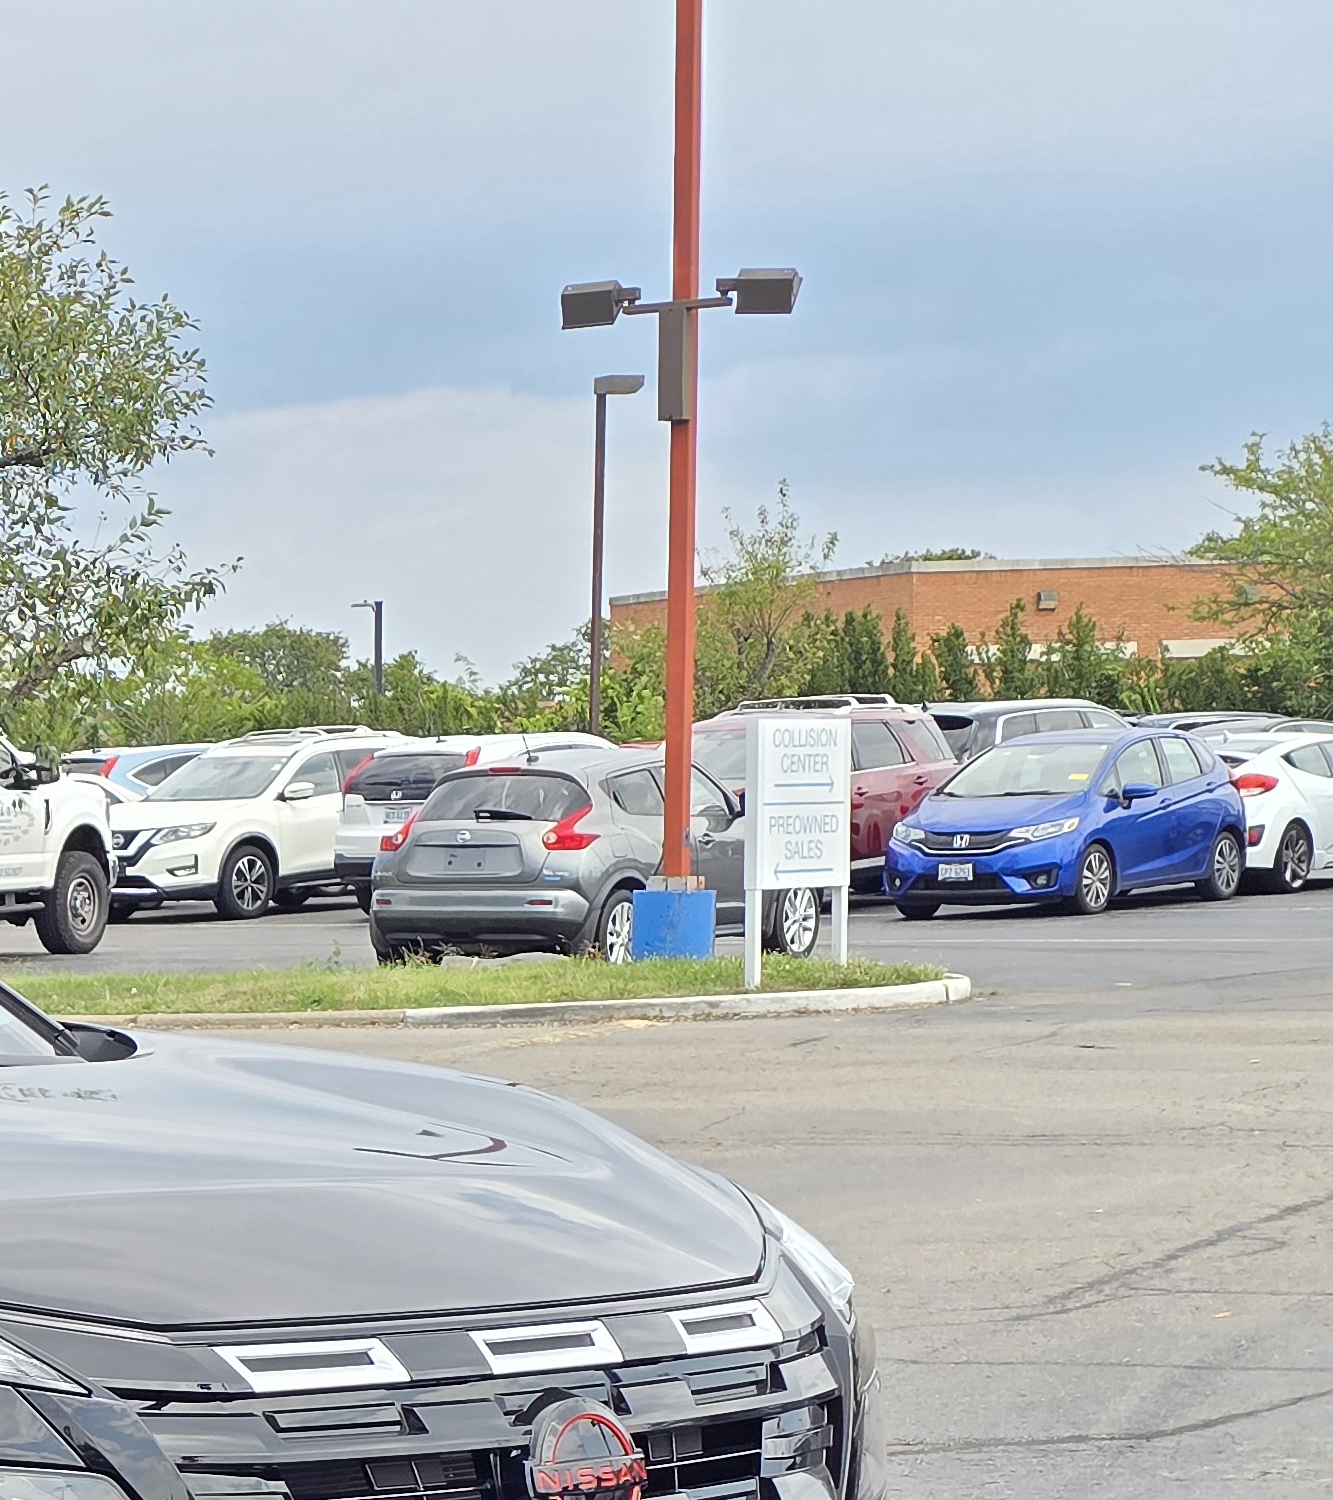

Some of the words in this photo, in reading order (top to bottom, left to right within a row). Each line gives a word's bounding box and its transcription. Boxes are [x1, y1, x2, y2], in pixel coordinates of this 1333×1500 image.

[773, 728, 837, 748] COLLISION
[780, 753, 829, 773] CENTER
[769, 814, 839, 835] PREOWNED
[784, 839, 823, 860] SALES
[538, 1460, 648, 1491] NISSAN
